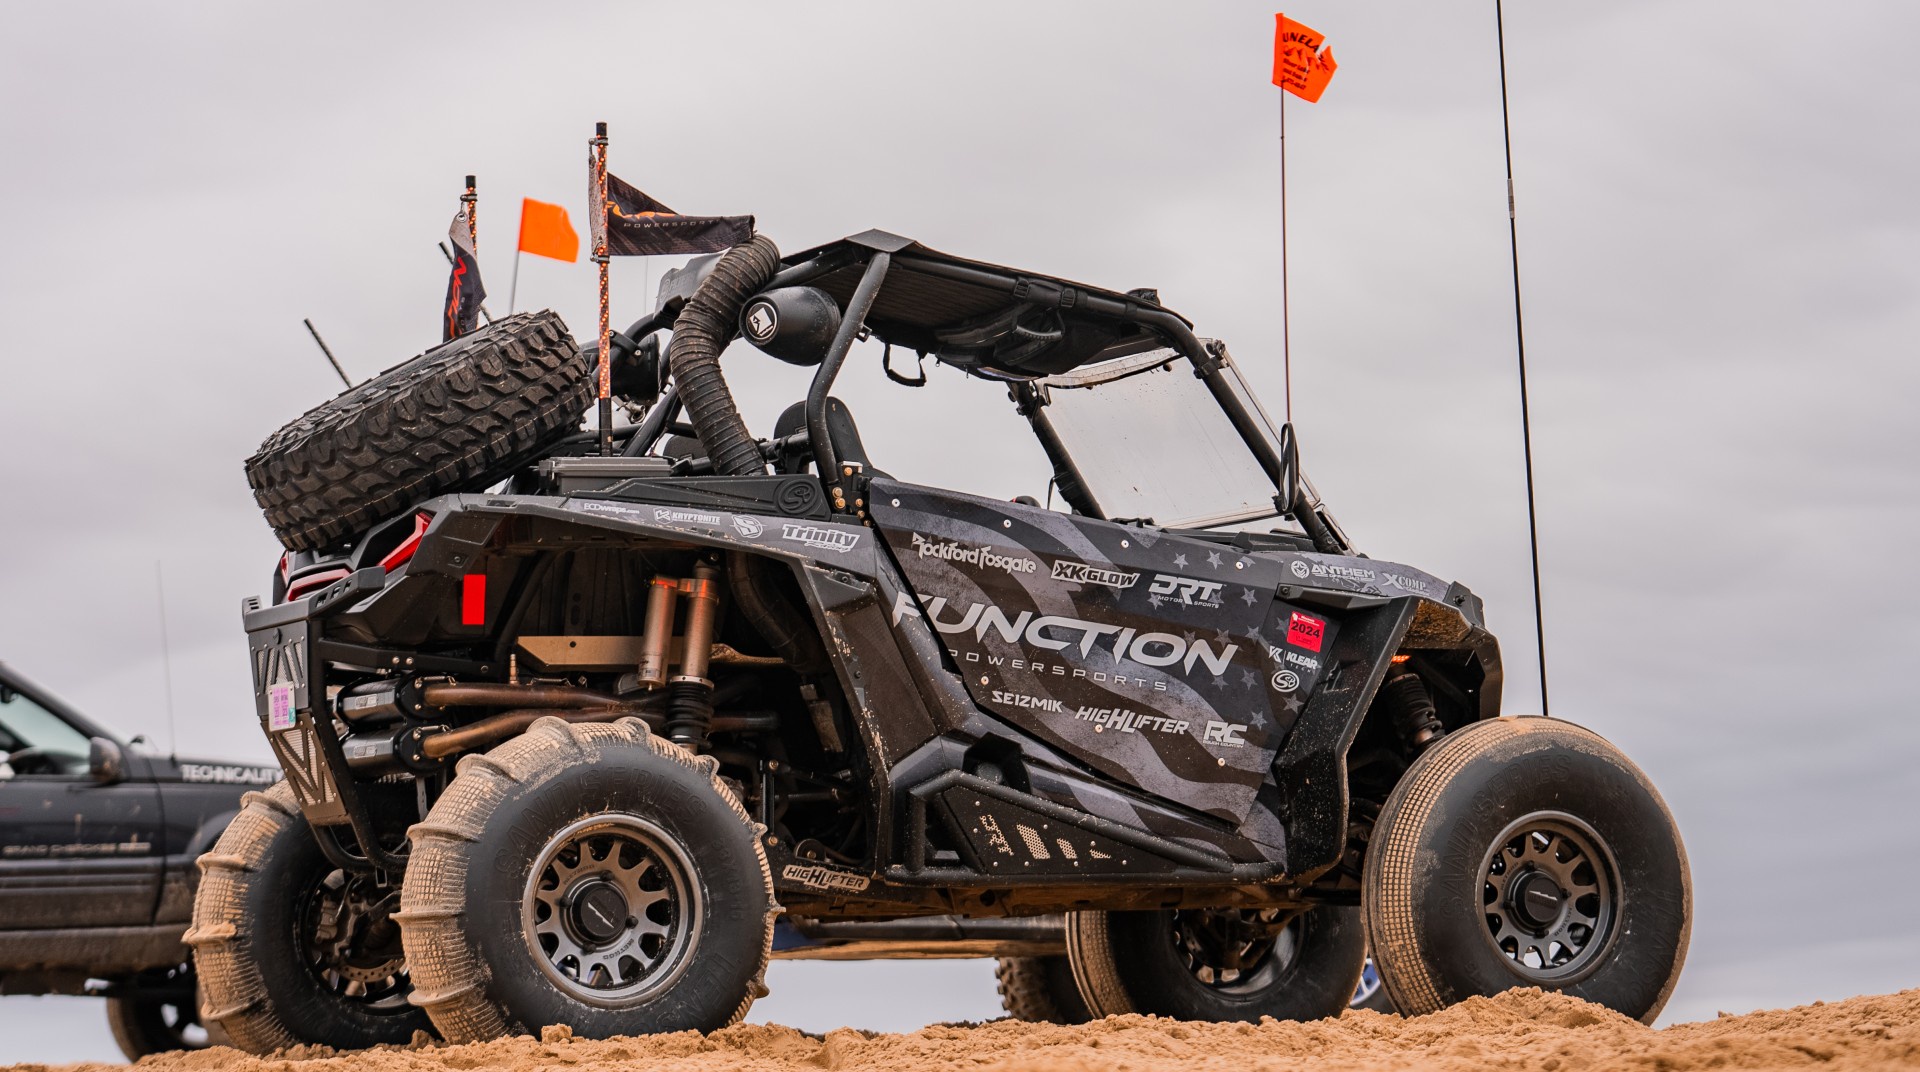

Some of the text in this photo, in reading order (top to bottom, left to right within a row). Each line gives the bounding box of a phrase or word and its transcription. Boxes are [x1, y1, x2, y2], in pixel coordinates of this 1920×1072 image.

[623, 219, 720, 229] POWERSPORT
[672, 511, 720, 523] KRYPTONITE
[782, 523, 860, 548] Trinity
[1052, 561, 1139, 588] XKGLOW
[1311, 564, 1375, 579] ANTHEM
[1149, 573, 1223, 605] DRT
[892, 591, 1238, 676] FUNCTION
[1291, 621, 1320, 638] 2024
[992, 690, 1063, 713] SEIZMIK
[1203, 720, 1248, 745] RC
[181, 764, 285, 785] TECHNICALITY
